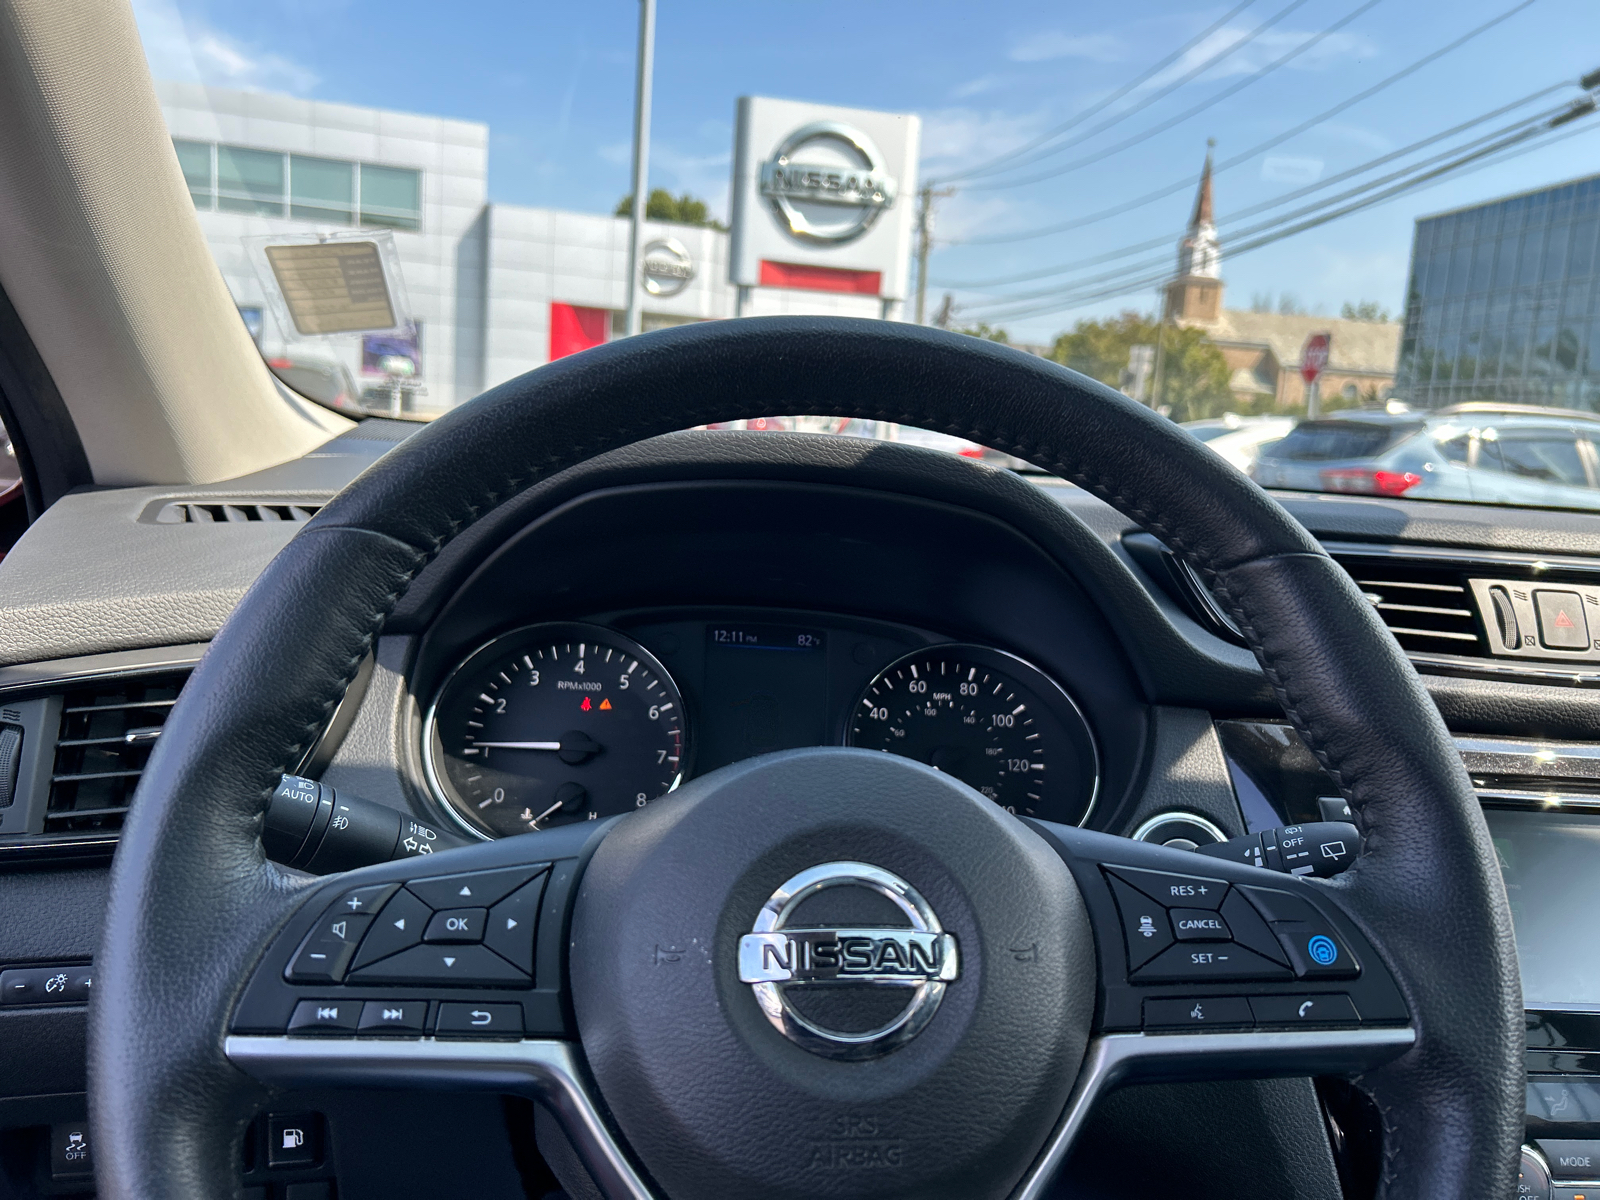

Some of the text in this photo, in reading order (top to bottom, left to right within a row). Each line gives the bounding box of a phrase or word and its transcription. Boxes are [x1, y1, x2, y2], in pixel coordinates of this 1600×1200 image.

[771, 169, 877, 198] NISSAN
[714, 629, 743, 643] 12:11
[574, 660, 585, 675] 4
[530, 670, 540, 686] 3
[619, 675, 629, 690] 5
[557, 681, 602, 692] RPMx1000
[908, 680, 928, 694] 60
[959, 682, 978, 697] 80
[932, 693, 951, 701] MPH
[496, 698, 507, 714] 2
[649, 705, 659, 720] 6
[924, 707, 936, 716] 100
[869, 707, 889, 721] 40
[992, 714, 1014, 728] 100
[895, 729, 905, 737] 60
[656, 750, 667, 765] 7
[1007, 758, 1029, 772] 120
[281, 787, 314, 804] AUTO
[494, 788, 504, 803] 0
[636, 792, 647, 808] 8
[588, 811, 598, 821] H
[1283, 837, 1305, 849] OFF
[1170, 885, 1195, 897] RES
[446, 917, 469, 932] OK
[1178, 919, 1222, 930] CANCEL
[762, 938, 939, 973] NISSAN
[1191, 953, 1213, 964] SET
[831, 1115, 879, 1138] SRS
[65, 1151, 87, 1161] OFF
[807, 1146, 903, 1169] AIRBAG
[1560, 1157, 1592, 1167] MODE
